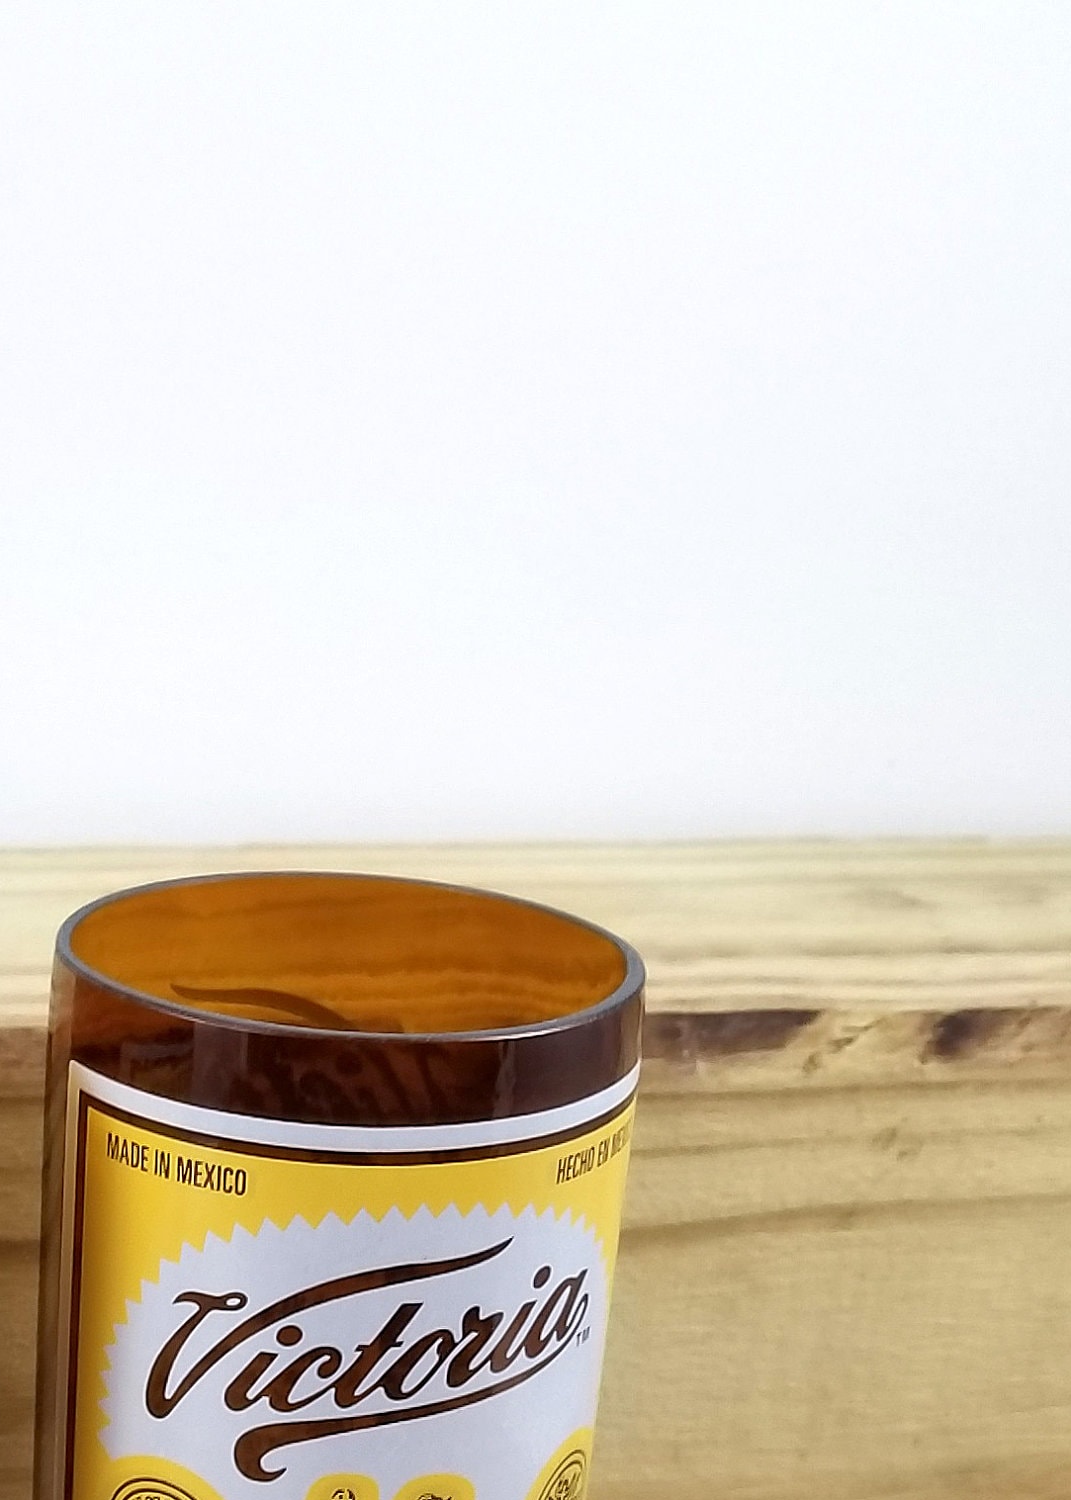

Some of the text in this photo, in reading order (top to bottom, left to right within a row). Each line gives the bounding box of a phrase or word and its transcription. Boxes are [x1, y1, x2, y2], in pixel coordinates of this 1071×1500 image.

[106, 1132, 247, 1197] MADE IN MEXICO
[556, 1146, 596, 1185] HECHO
[146, 1235, 589, 1483] Victoria
